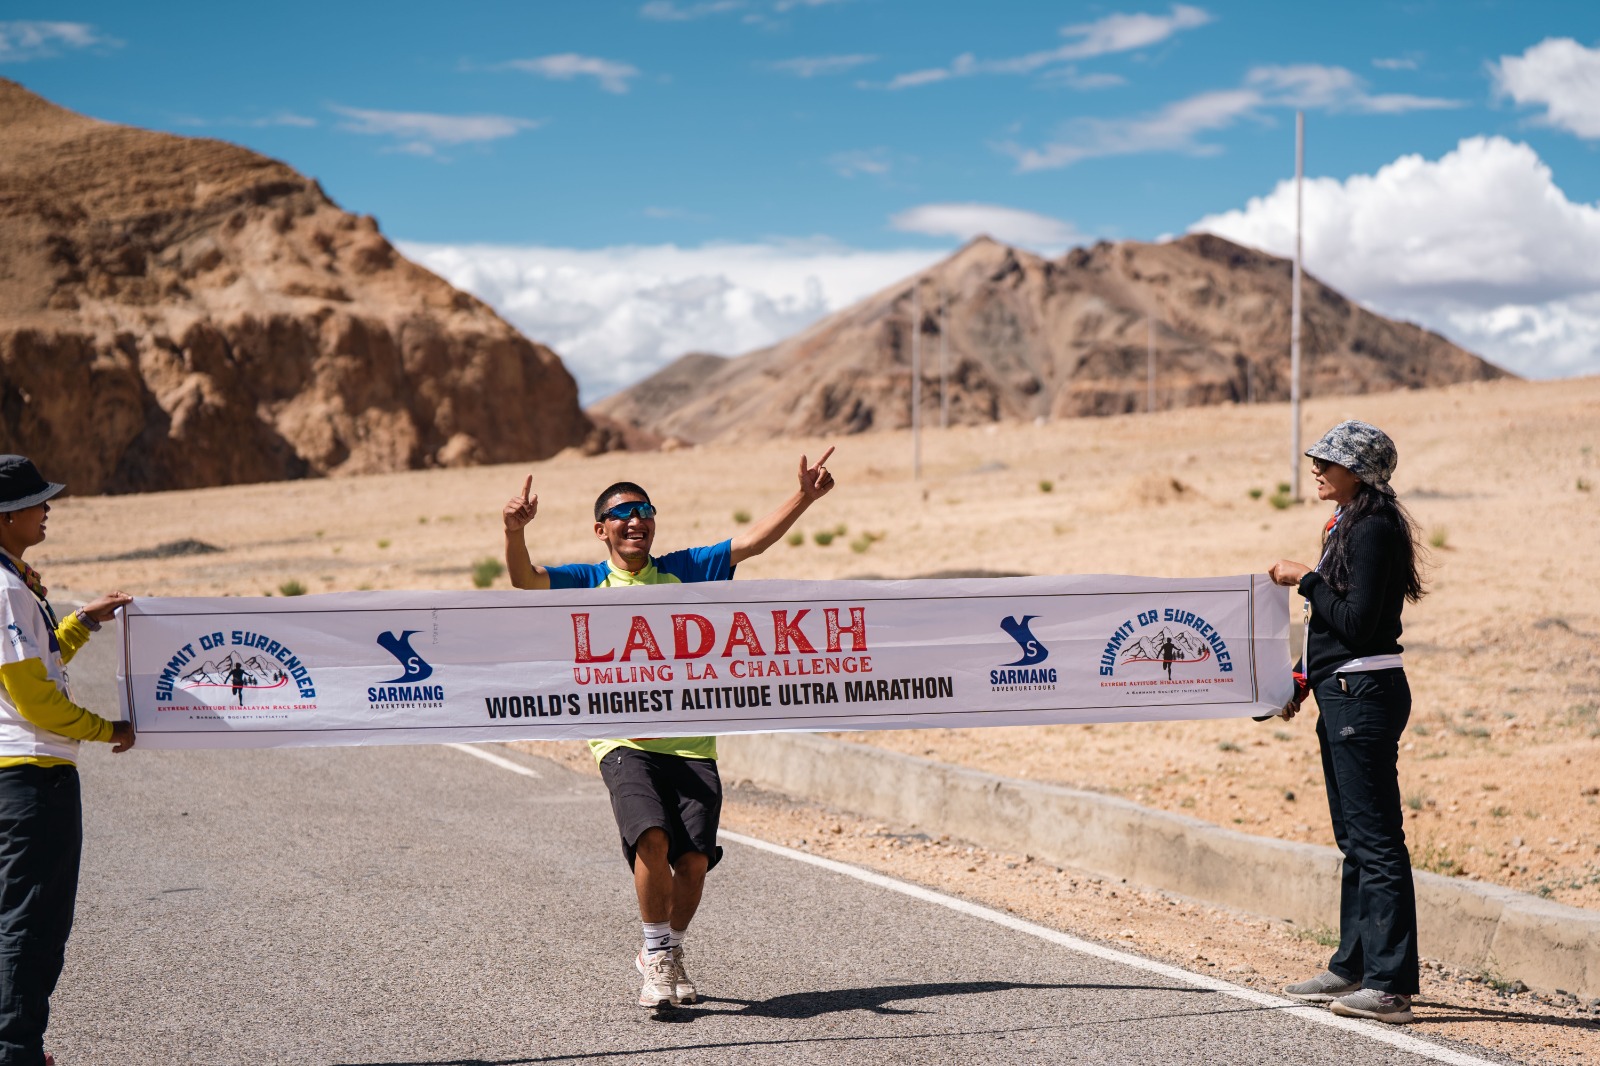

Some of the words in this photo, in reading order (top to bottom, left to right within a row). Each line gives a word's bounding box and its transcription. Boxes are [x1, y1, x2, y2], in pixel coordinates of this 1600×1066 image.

[570, 607, 868, 664] LADAKH
[1100, 620, 1135, 676] SUMMIT
[1137, 609, 1158, 627] OR
[1164, 608, 1234, 672] SURRENDER
[156, 643, 197, 701] SUMMIT
[198, 631, 225, 651] OR
[231, 630, 316, 699] SURRENDER
[573, 664, 674, 685] UMLING
[686, 662, 718, 680] LA
[729, 656, 873, 679] CHALLENGE
[990, 668, 1057, 685] SARMANG
[367, 685, 444, 702] SARMANG
[485, 693, 581, 719] WORLD'S
[588, 689, 674, 714] HIGHEST
[681, 684, 772, 710] ALTITUDE
[778, 682, 839, 705] ULTRA
[844, 676, 954, 703] MARATHON
